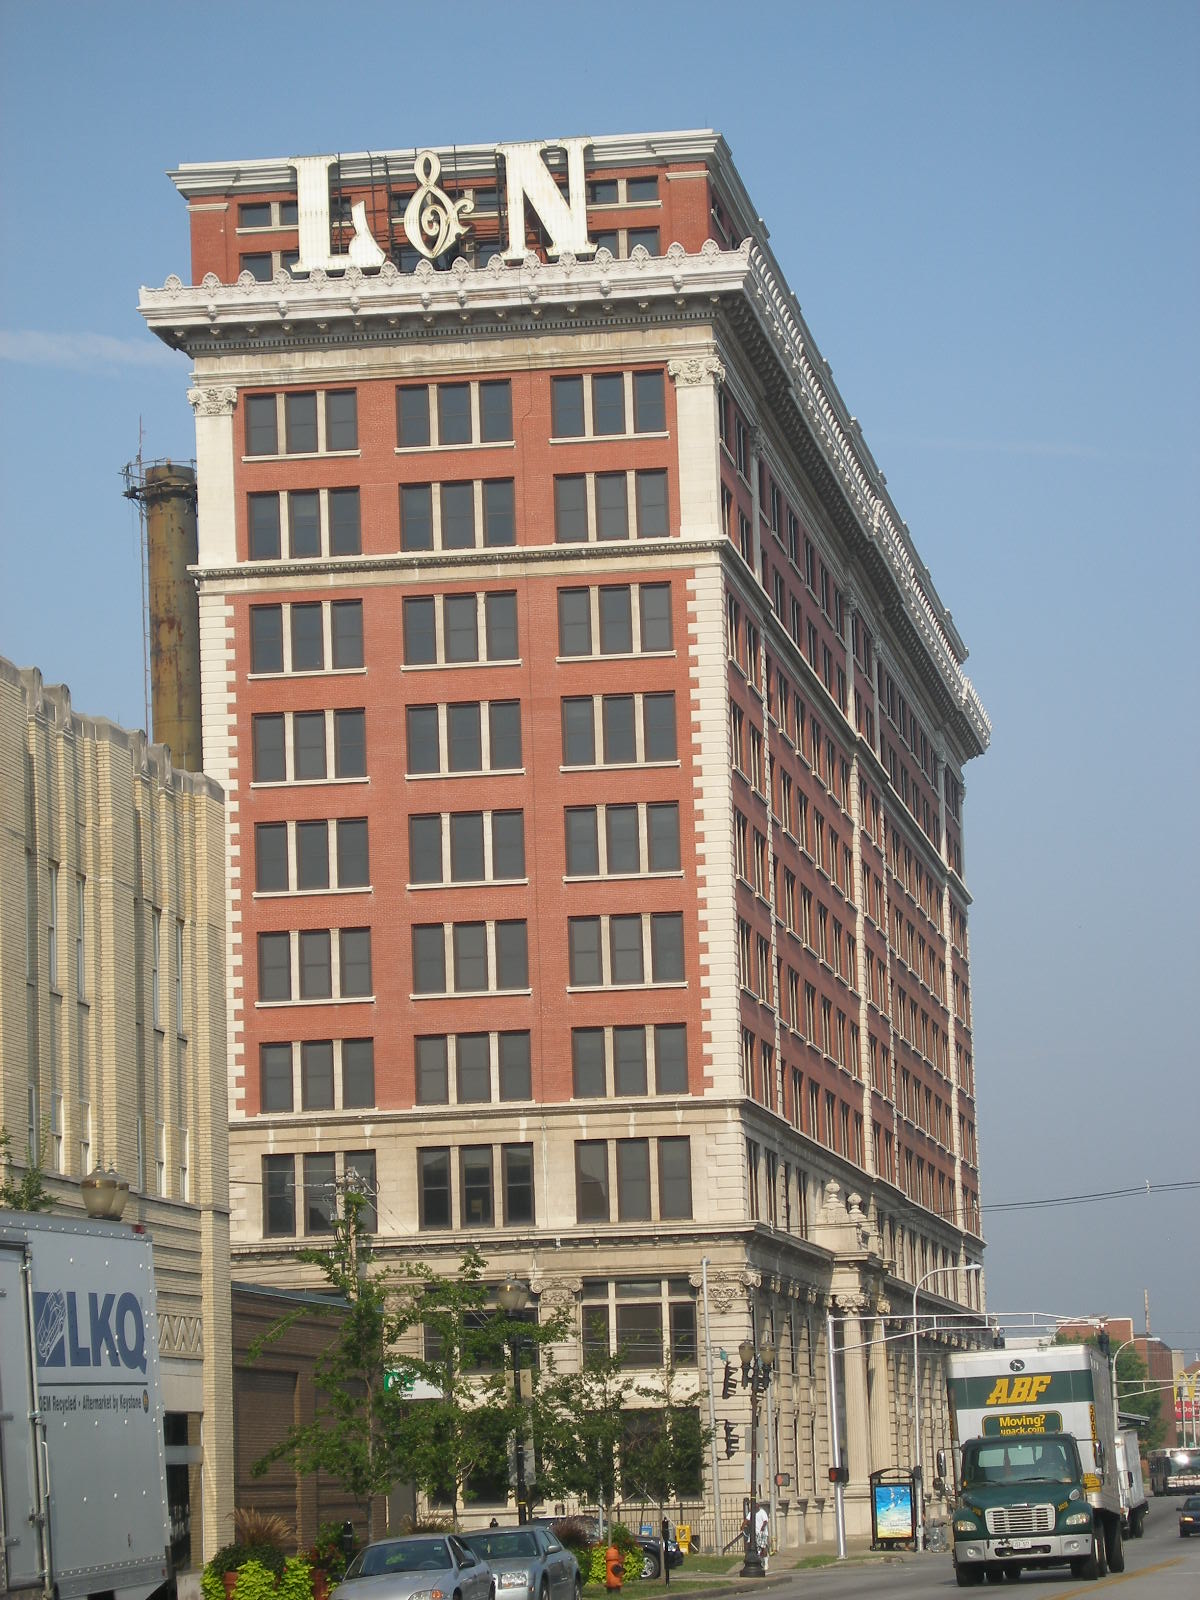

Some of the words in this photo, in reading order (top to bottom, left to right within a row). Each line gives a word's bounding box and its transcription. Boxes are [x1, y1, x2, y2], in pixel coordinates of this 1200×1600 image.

[287, 154, 386, 273] L
[404, 149, 475, 259] &
[495, 136, 599, 261] N
[66, 1291, 147, 1375] LKQ
[53, 1395, 77, 1415] Recycled
[82, 1394, 112, 1410] Aftermarket
[113, 1394, 118, 1413] by
[120, 1394, 142, 1413] Keystone
[986, 1375, 1052, 1405] ABF
[1000, 1414, 1046, 1427] Moving?
